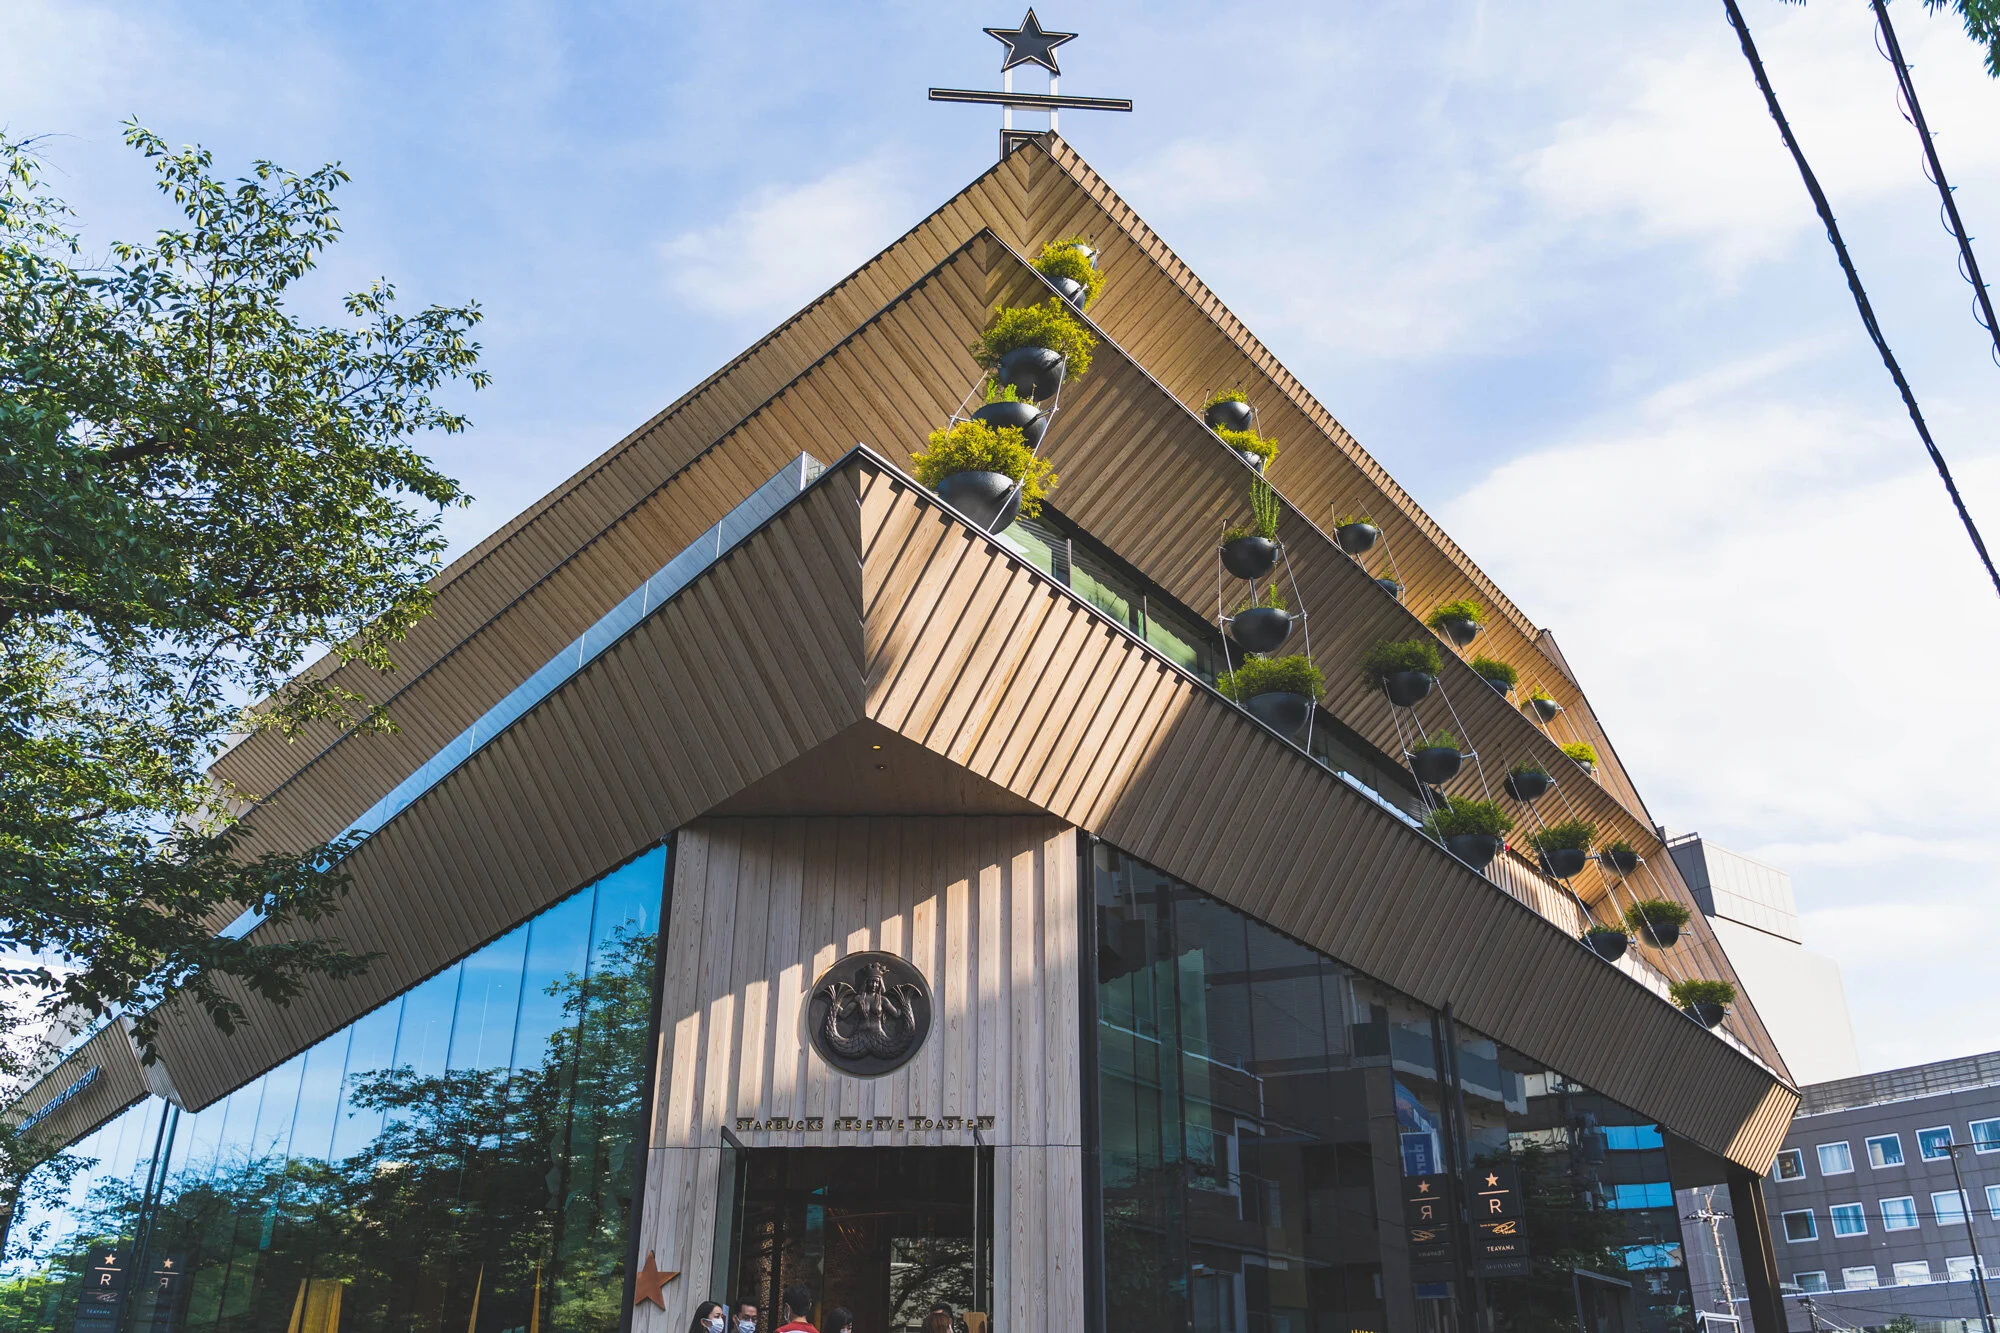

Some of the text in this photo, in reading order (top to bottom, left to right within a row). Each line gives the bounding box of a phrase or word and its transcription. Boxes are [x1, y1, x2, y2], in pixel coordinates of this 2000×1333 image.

[736, 1119, 994, 1130] STARBUCKS RESERVE ROASTERY
[1489, 1199, 1502, 1214] R
[1487, 1244, 1515, 1252] TEAVANA
[100, 1273, 112, 1286] R
